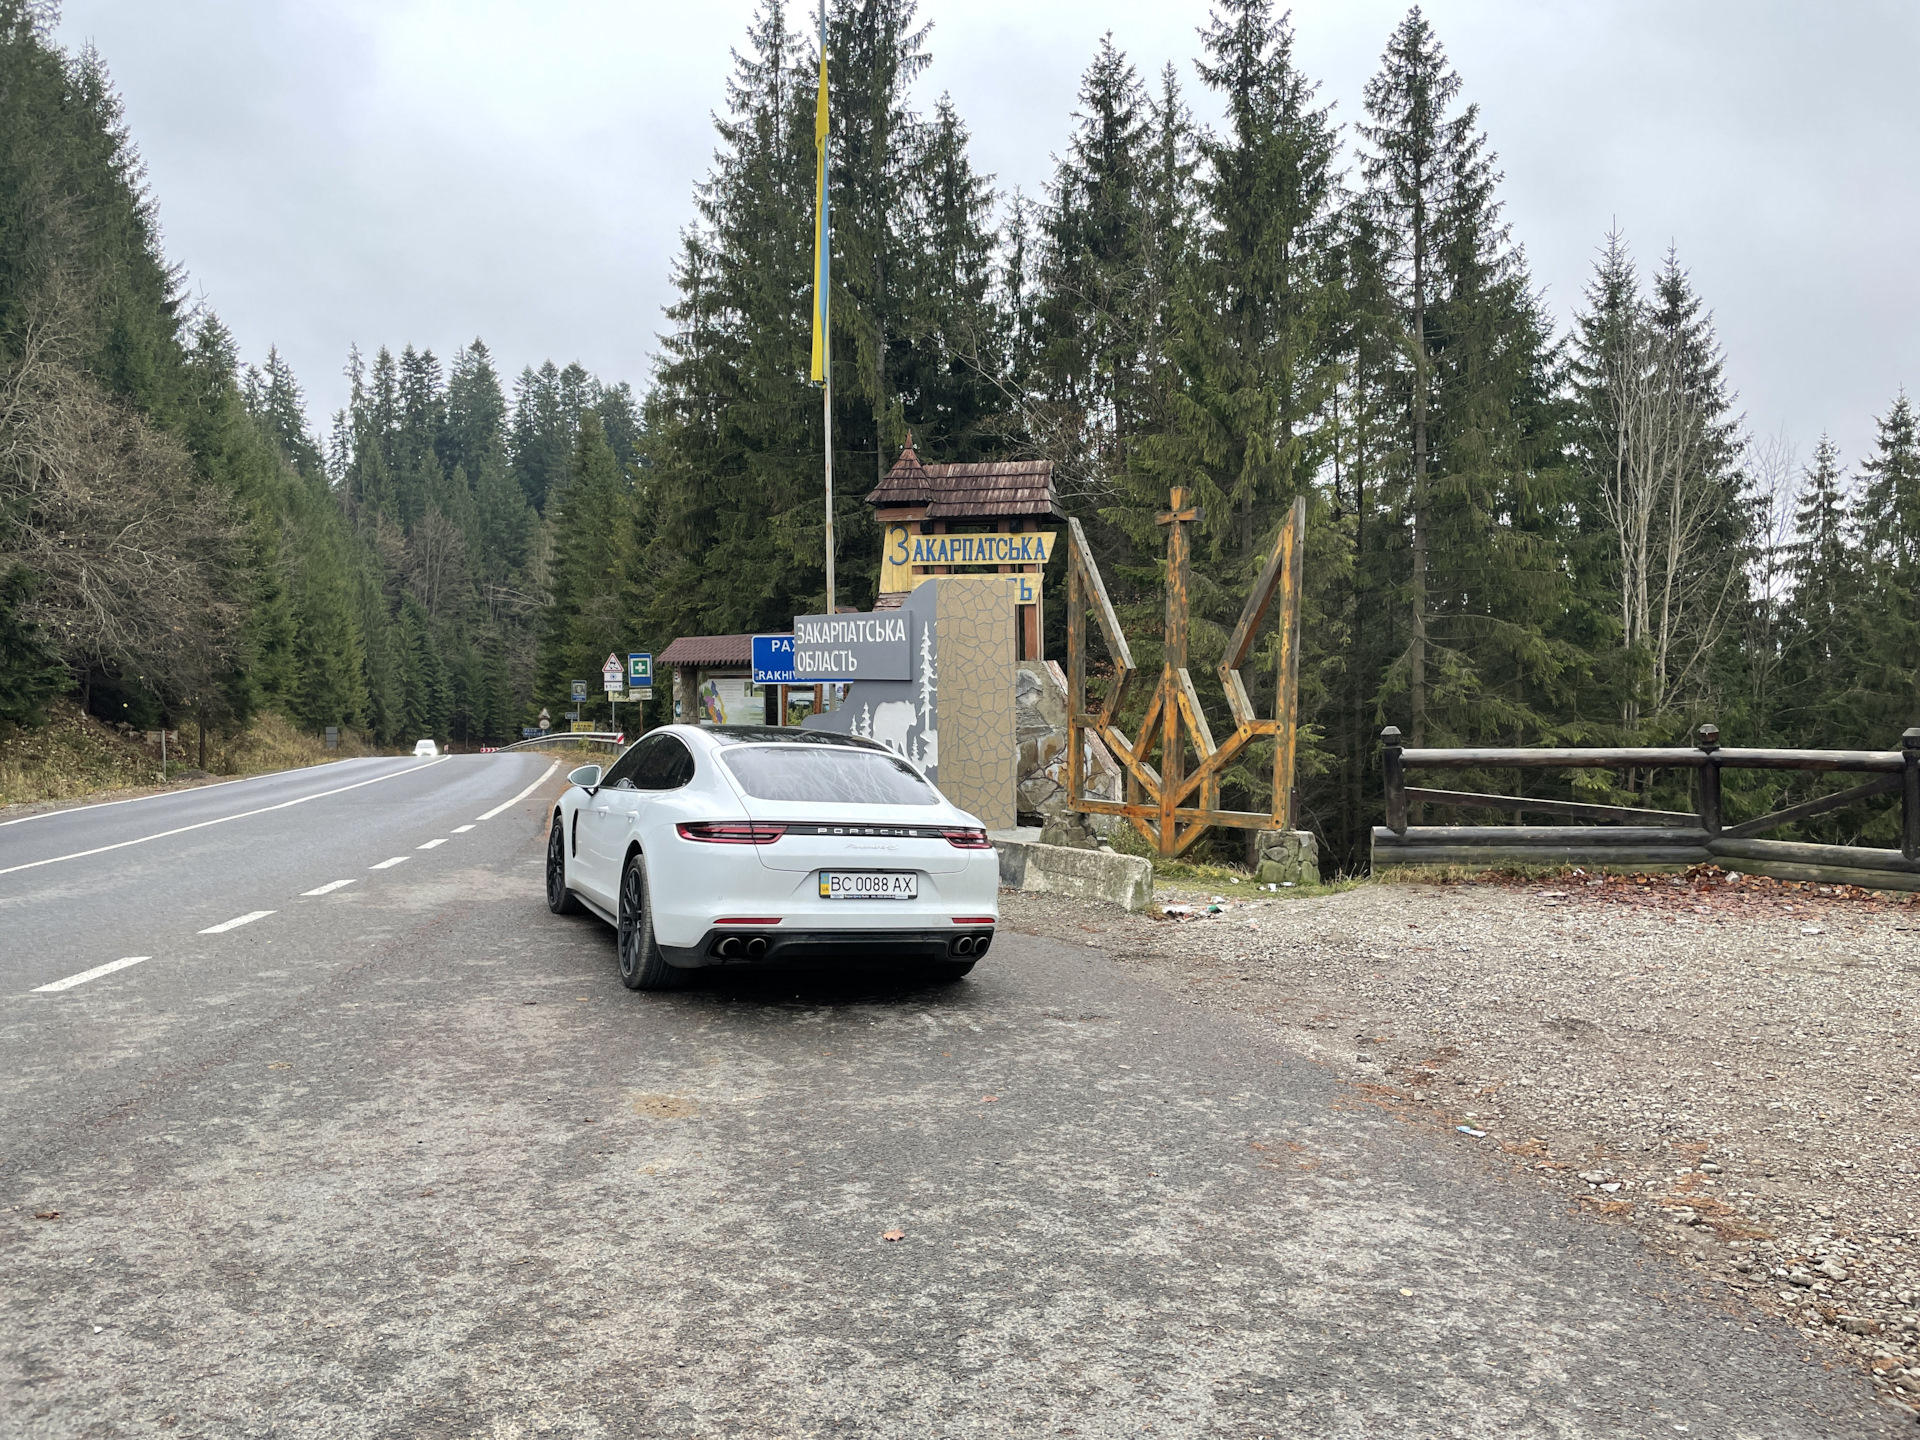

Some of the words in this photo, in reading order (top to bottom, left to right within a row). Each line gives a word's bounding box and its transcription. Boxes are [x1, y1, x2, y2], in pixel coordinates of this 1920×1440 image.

[888, 525, 1047, 565] ЗАКАРПАТСЬКА
[797, 617, 907, 644] ЗАКАРПАТСЬКА
[797, 649, 858, 672] ОБЛАСТЬ
[818, 828, 918, 836] PORSCHE
[831, 876, 852, 892] BC
[855, 876, 888, 892] 0088
[893, 877, 912, 892] AX
